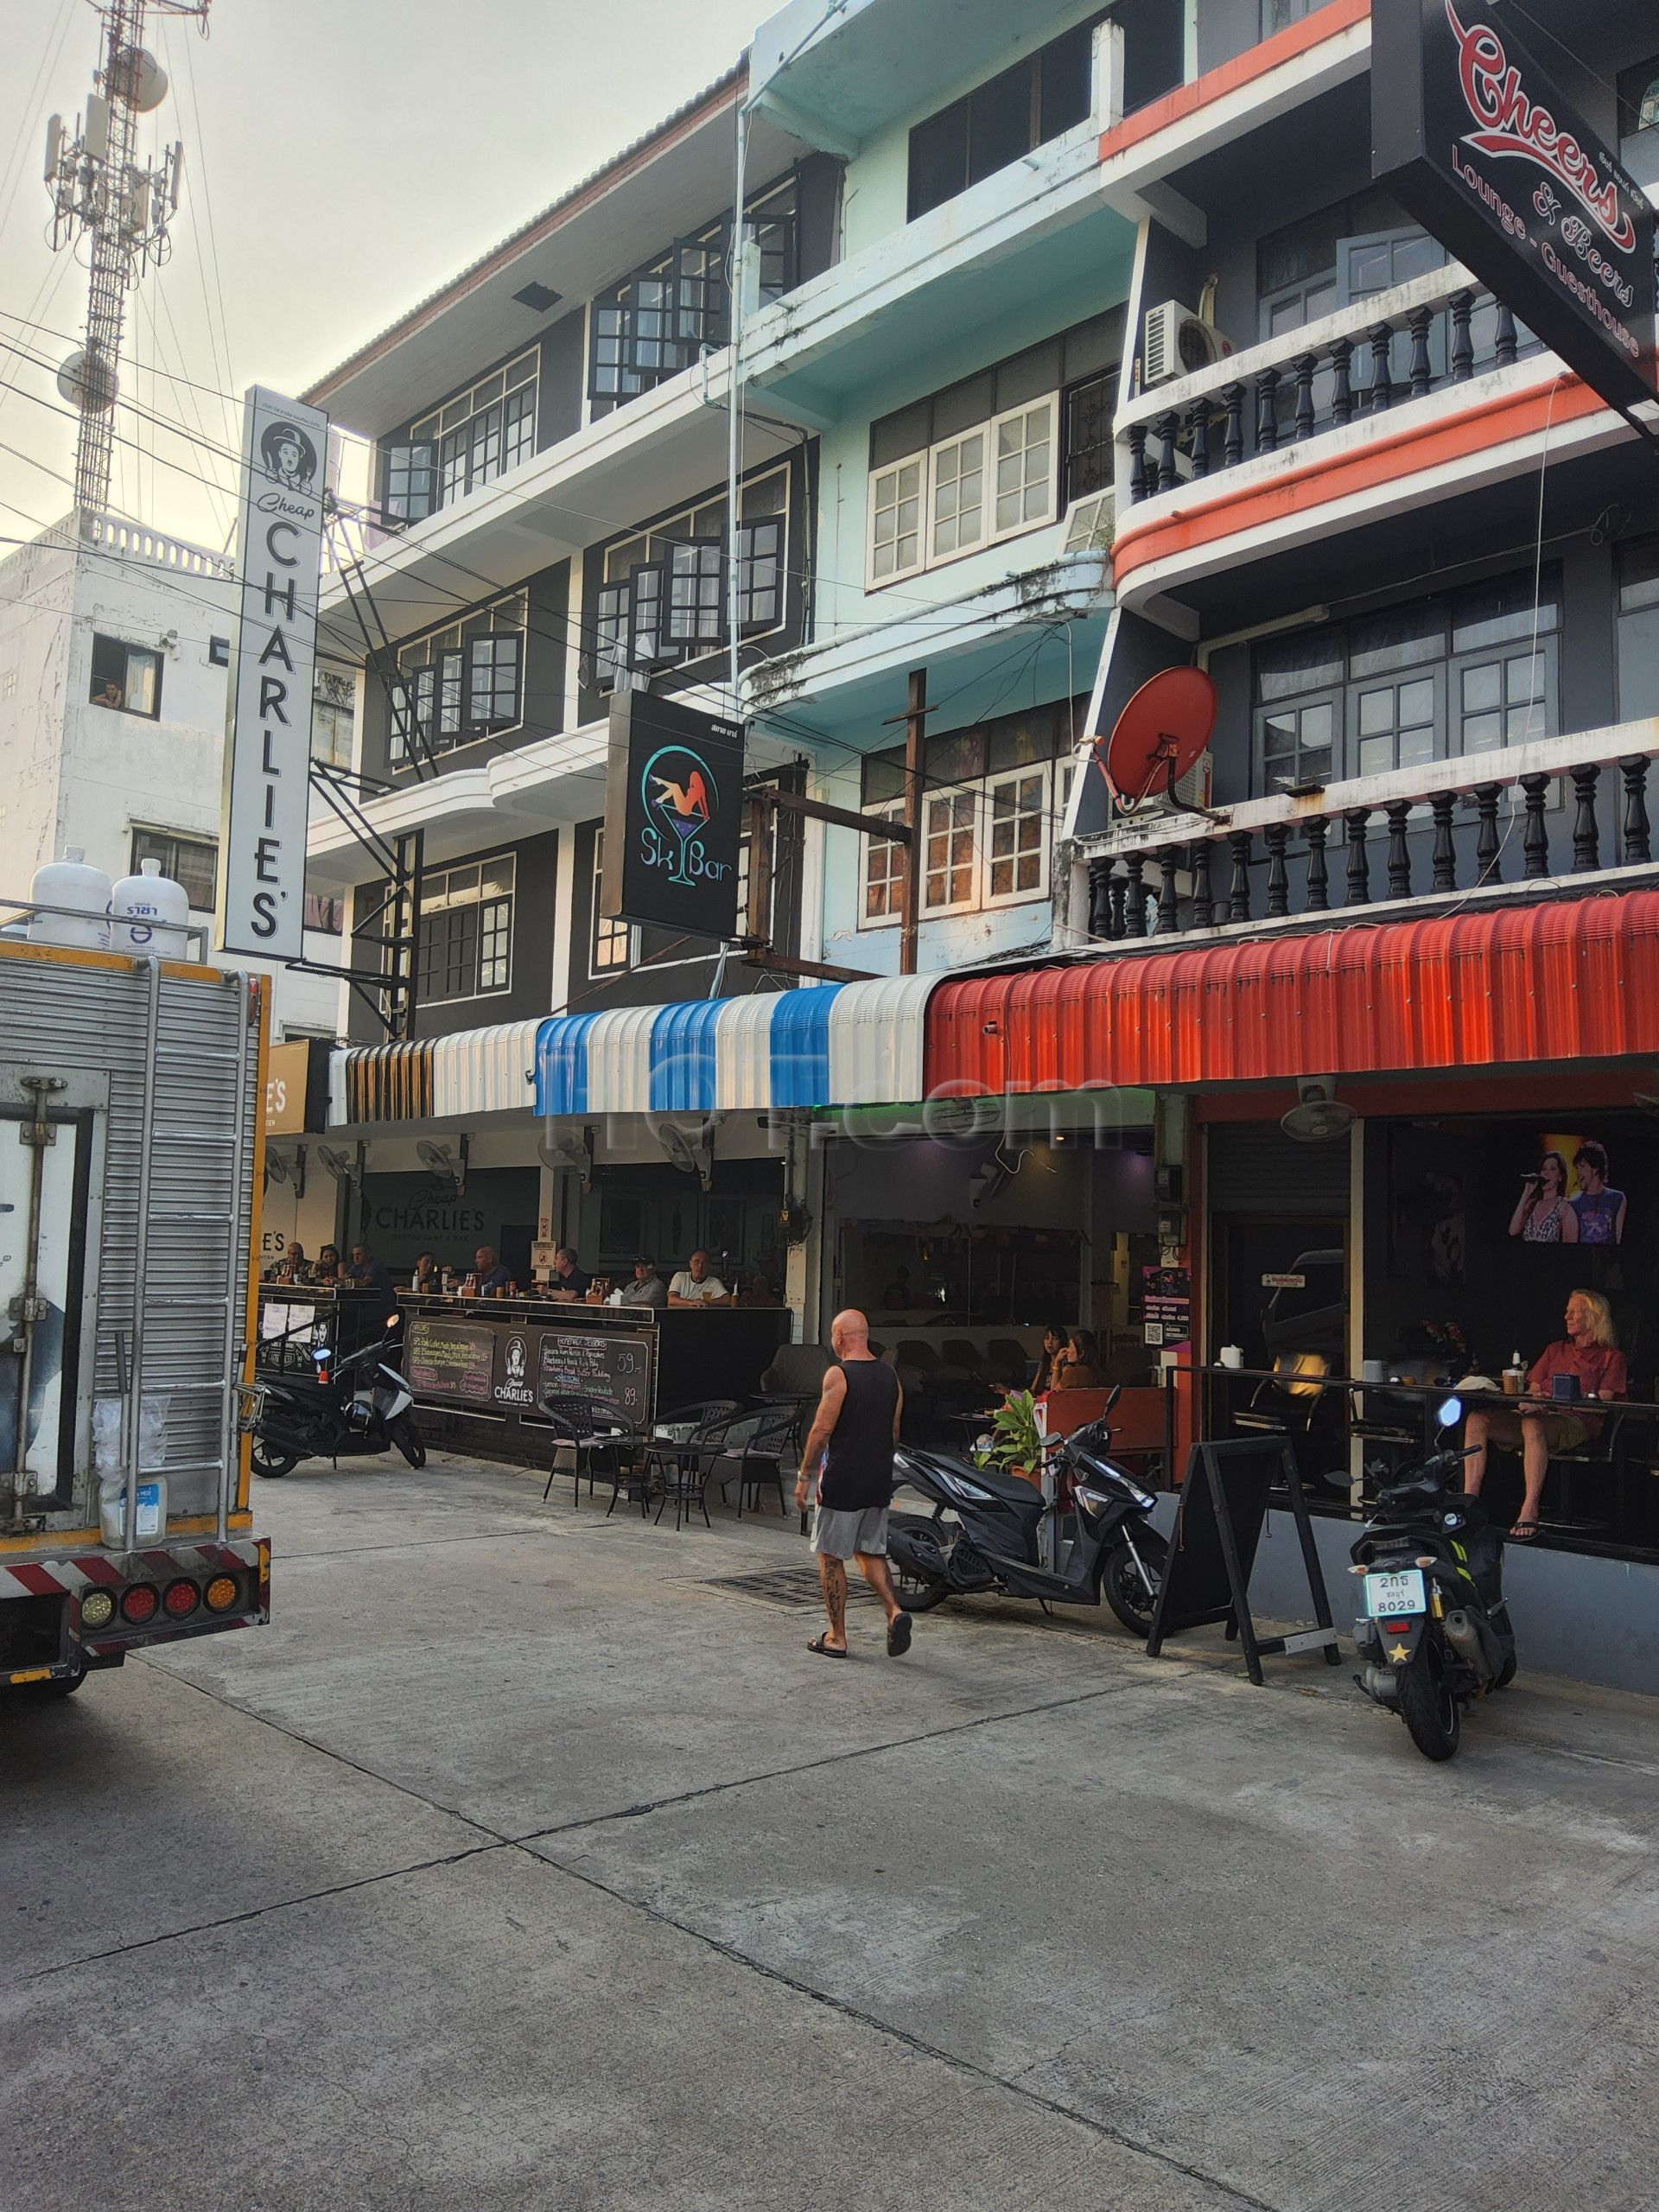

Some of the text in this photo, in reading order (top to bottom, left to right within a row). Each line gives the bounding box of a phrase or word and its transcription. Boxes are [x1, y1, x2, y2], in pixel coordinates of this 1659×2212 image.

[1445, 0, 1618, 231] Cheers
[1451, 144, 1528, 241] Lounge
[1541, 240, 1641, 359] Guesthouse
[1560, 215, 1635, 308] Beers
[257, 492, 315, 520] Cheap
[689, 839, 733, 882] Bar
[376, 1208, 485, 1231] CHARLIE'S
[493, 1385, 534, 1403] CHARLIE'S
[1380, 1575, 1408, 1588] 2กธ
[1378, 1599, 1415, 1612] 8029
